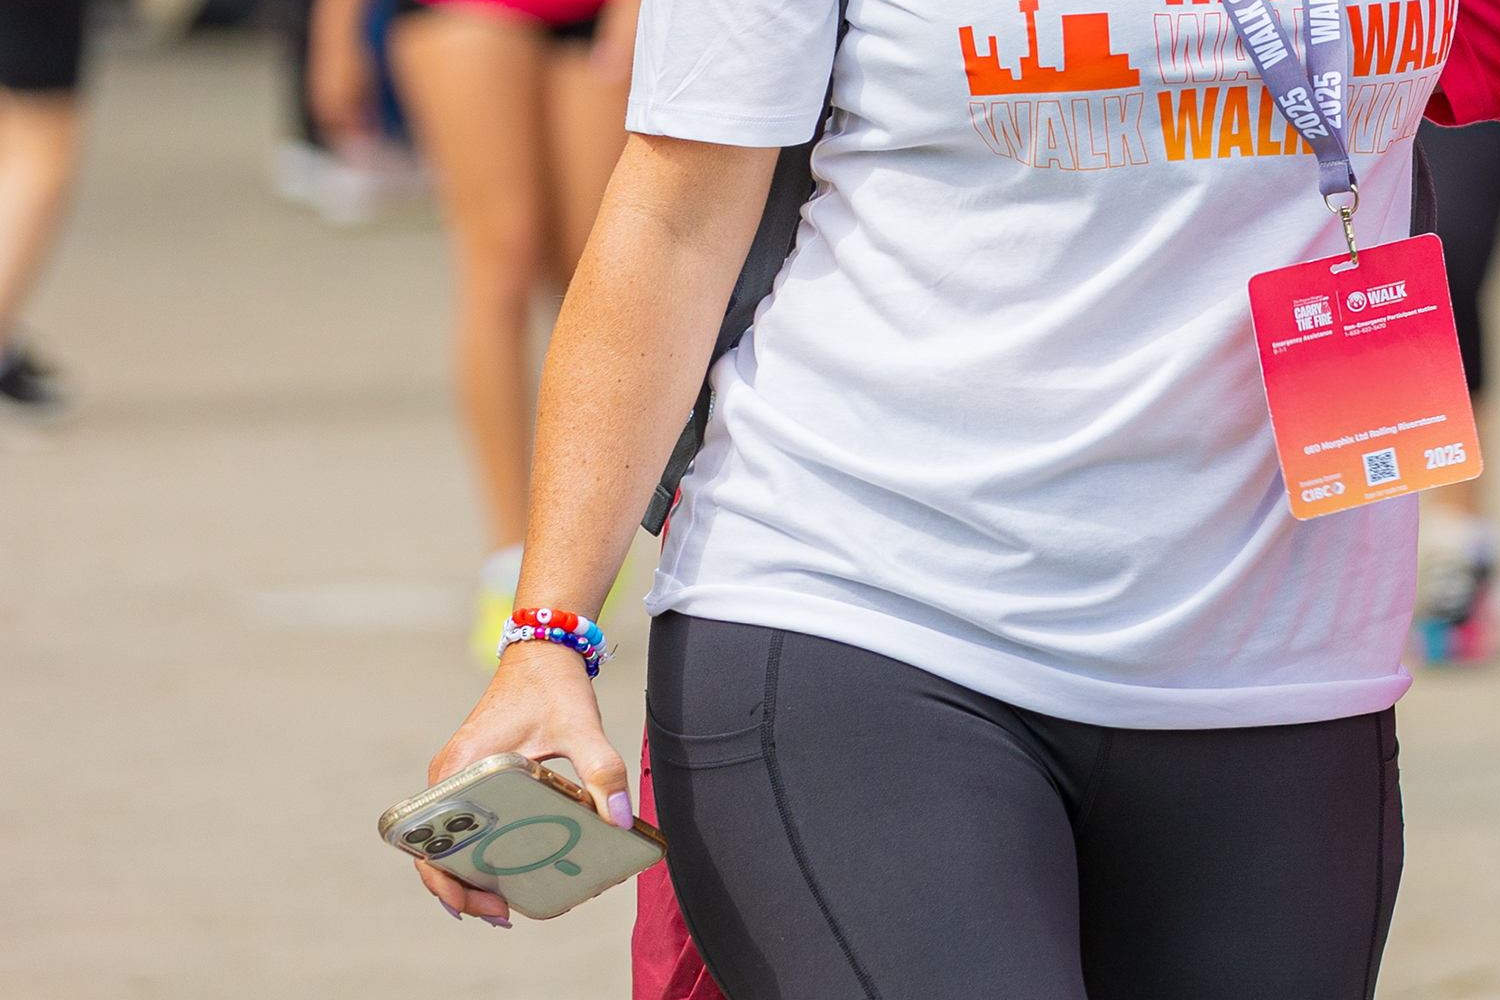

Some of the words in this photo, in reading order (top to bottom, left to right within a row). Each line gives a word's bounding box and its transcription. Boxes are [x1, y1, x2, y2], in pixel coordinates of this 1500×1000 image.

[1234, 0, 1288, 70] WALK
[1313, 71, 1342, 129] 2025
[1278, 87, 1329, 140] 2025
[969, 92, 1148, 171] WALK
[1366, 283, 1407, 305] WALK
[1294, 302, 1322, 320] CARRY
[1296, 316, 1314, 332] THE
[1314, 312, 1333, 328] FIRE
[1343, 317, 1387, 331] Non-Emergency
[1387, 309, 1417, 322] Participant
[1354, 431, 1369, 442] Ltd
[1368, 425, 1398, 439] Rolling
[1423, 442, 1467, 470] 2025
[1301, 485, 1333, 503] CIBC
